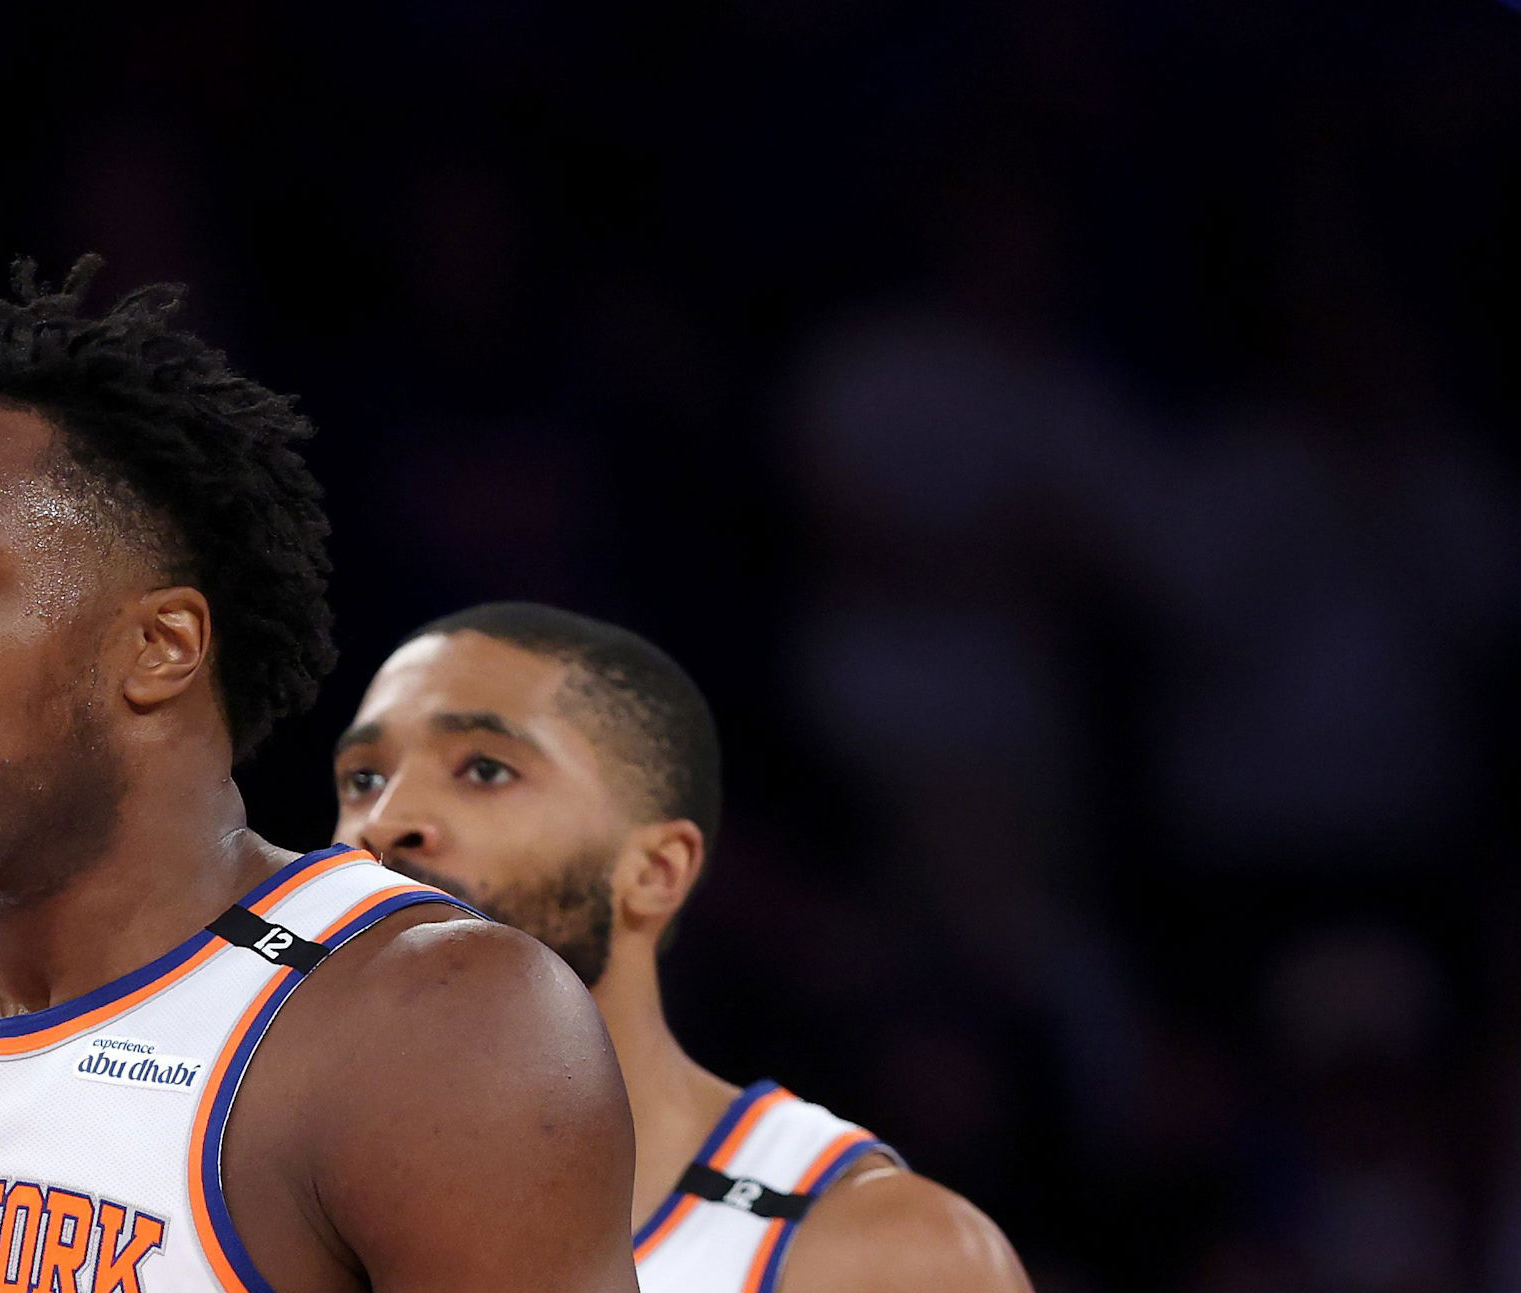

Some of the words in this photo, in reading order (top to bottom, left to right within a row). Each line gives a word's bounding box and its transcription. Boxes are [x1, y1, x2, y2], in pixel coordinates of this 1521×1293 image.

[253, 926, 294, 960] 12
[92, 1038, 155, 1055] experience
[77, 1051, 127, 1078] abu
[128, 1058, 201, 1087] dhabi
